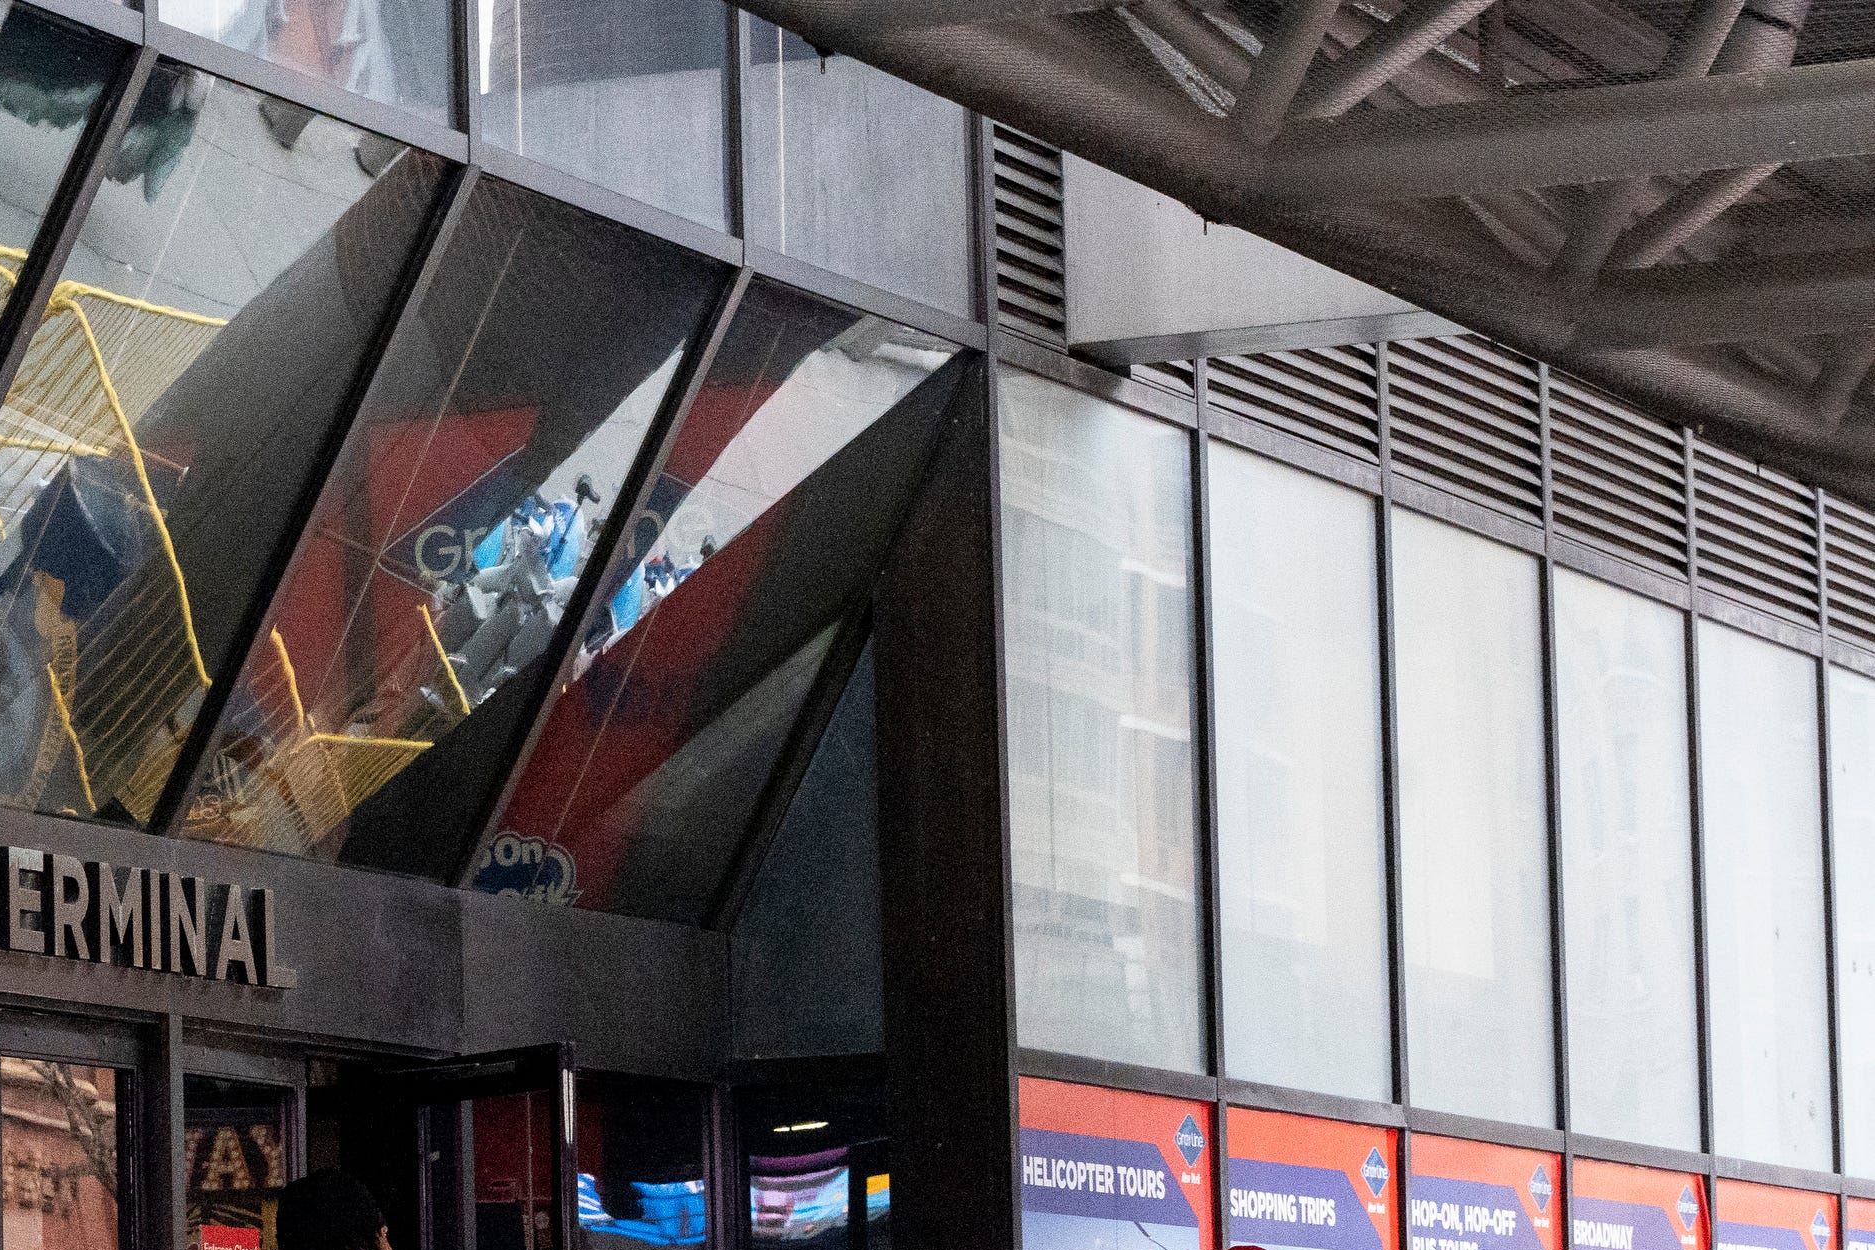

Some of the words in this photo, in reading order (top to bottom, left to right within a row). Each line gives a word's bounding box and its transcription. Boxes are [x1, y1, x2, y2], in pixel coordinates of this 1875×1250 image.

[1022, 1155, 1115, 1195] HELICOPTER
[1117, 1165, 1166, 1200] TOURS
[1229, 1187, 1297, 1223] SHOPPING
[1298, 1195, 1337, 1227] TRIPS
[1411, 1198, 1464, 1237] HOP-ON,
[1464, 1204, 1517, 1237] HOP-OFF
[1573, 1219, 1634, 1250] BROADWAY
